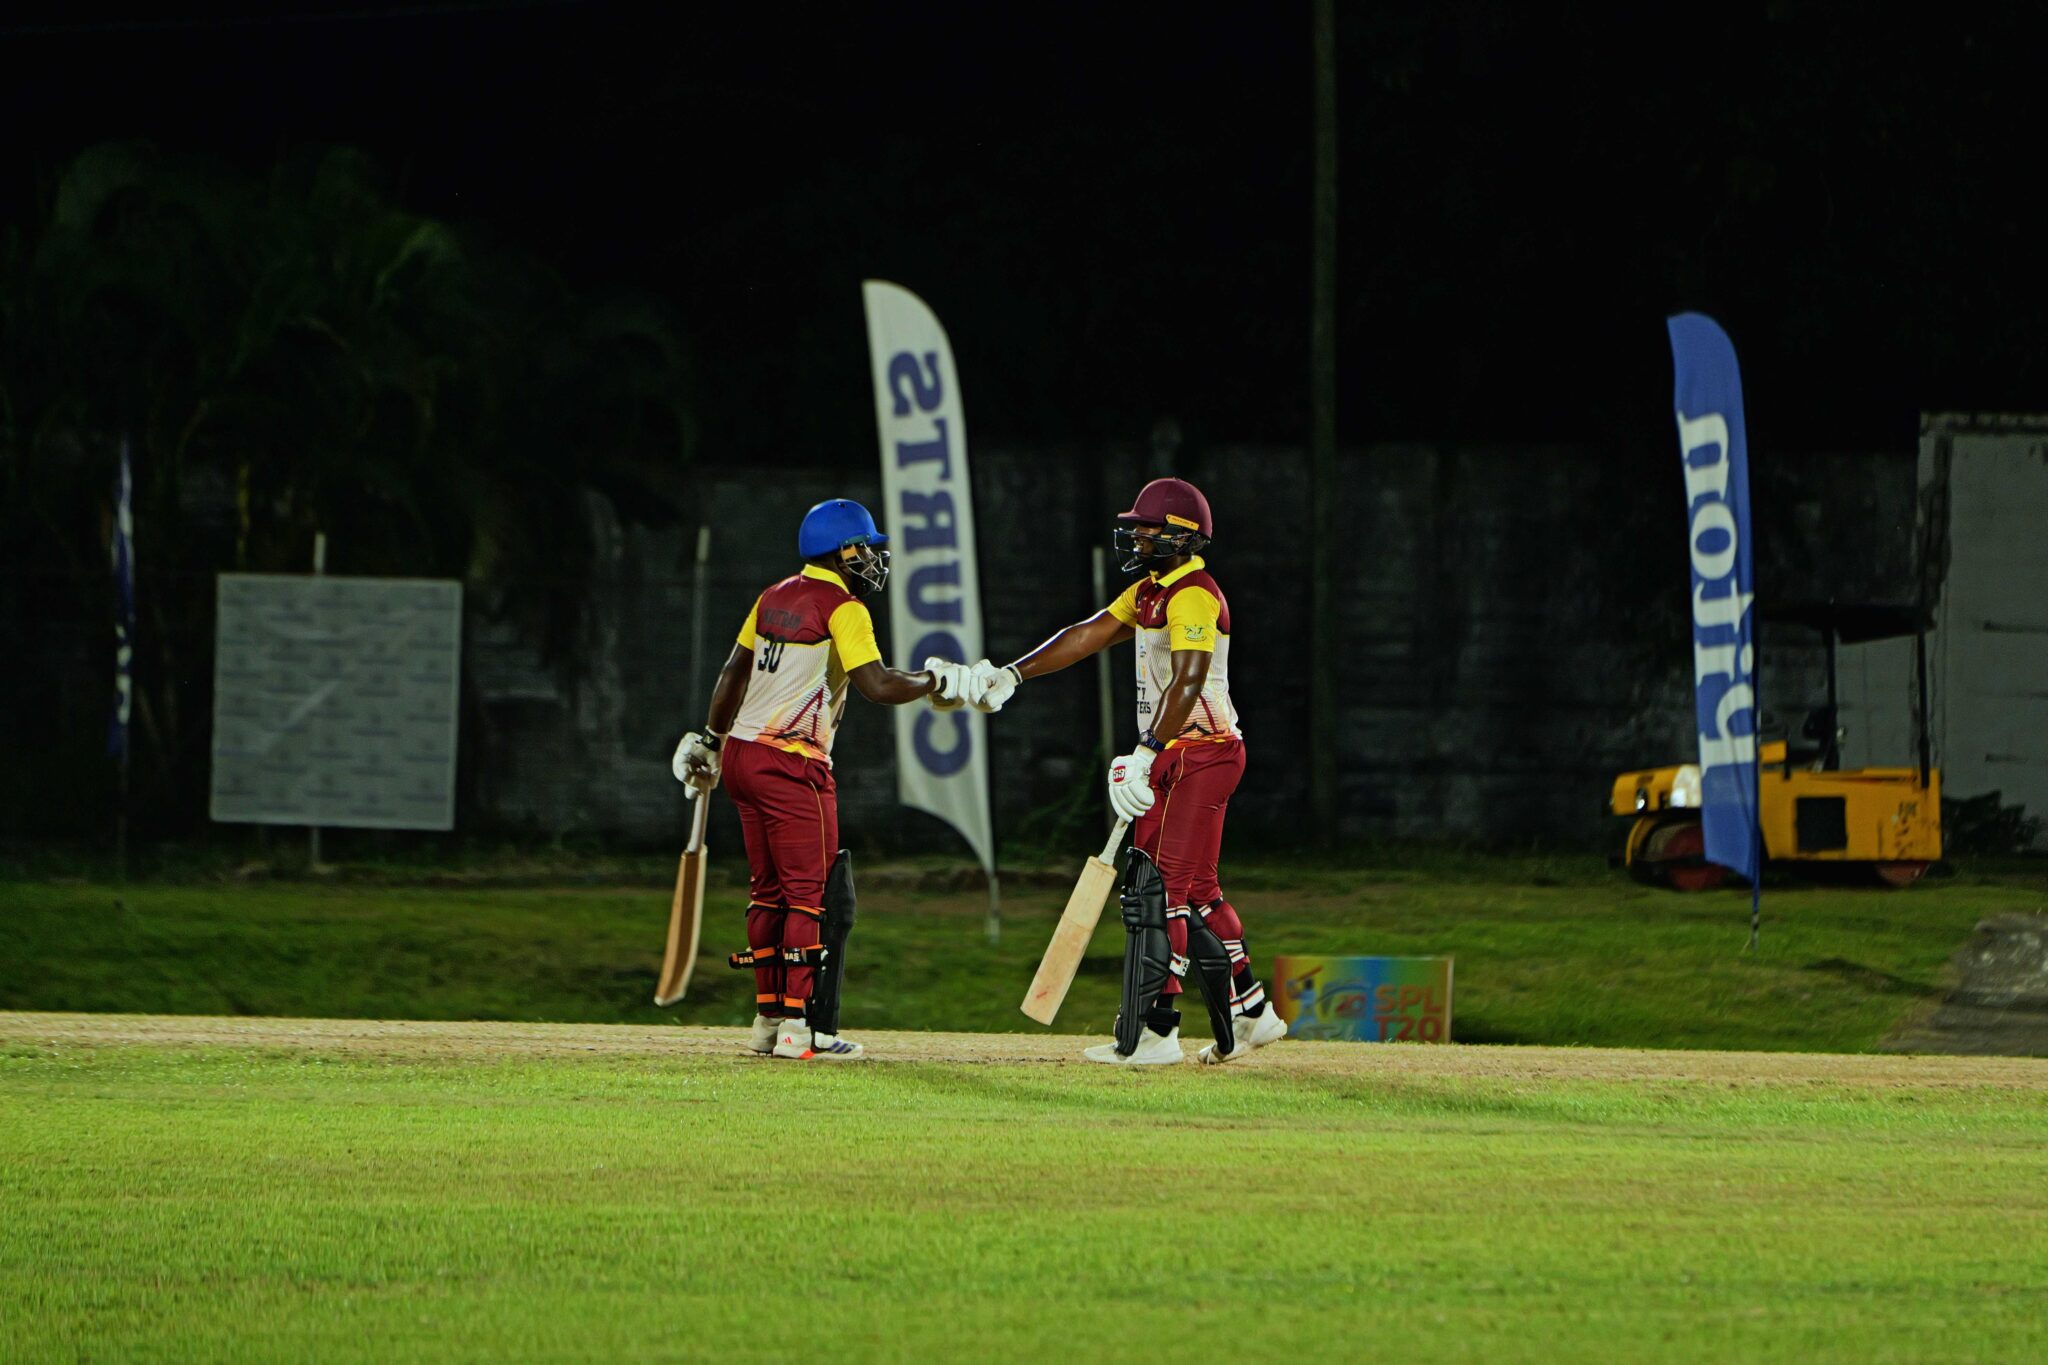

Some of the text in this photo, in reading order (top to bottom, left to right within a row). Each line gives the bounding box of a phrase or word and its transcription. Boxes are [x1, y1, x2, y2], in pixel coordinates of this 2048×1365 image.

[758, 633, 786, 673] 30
[1375, 984, 1441, 1012] SPL
[1374, 1015, 1441, 1041] T20
